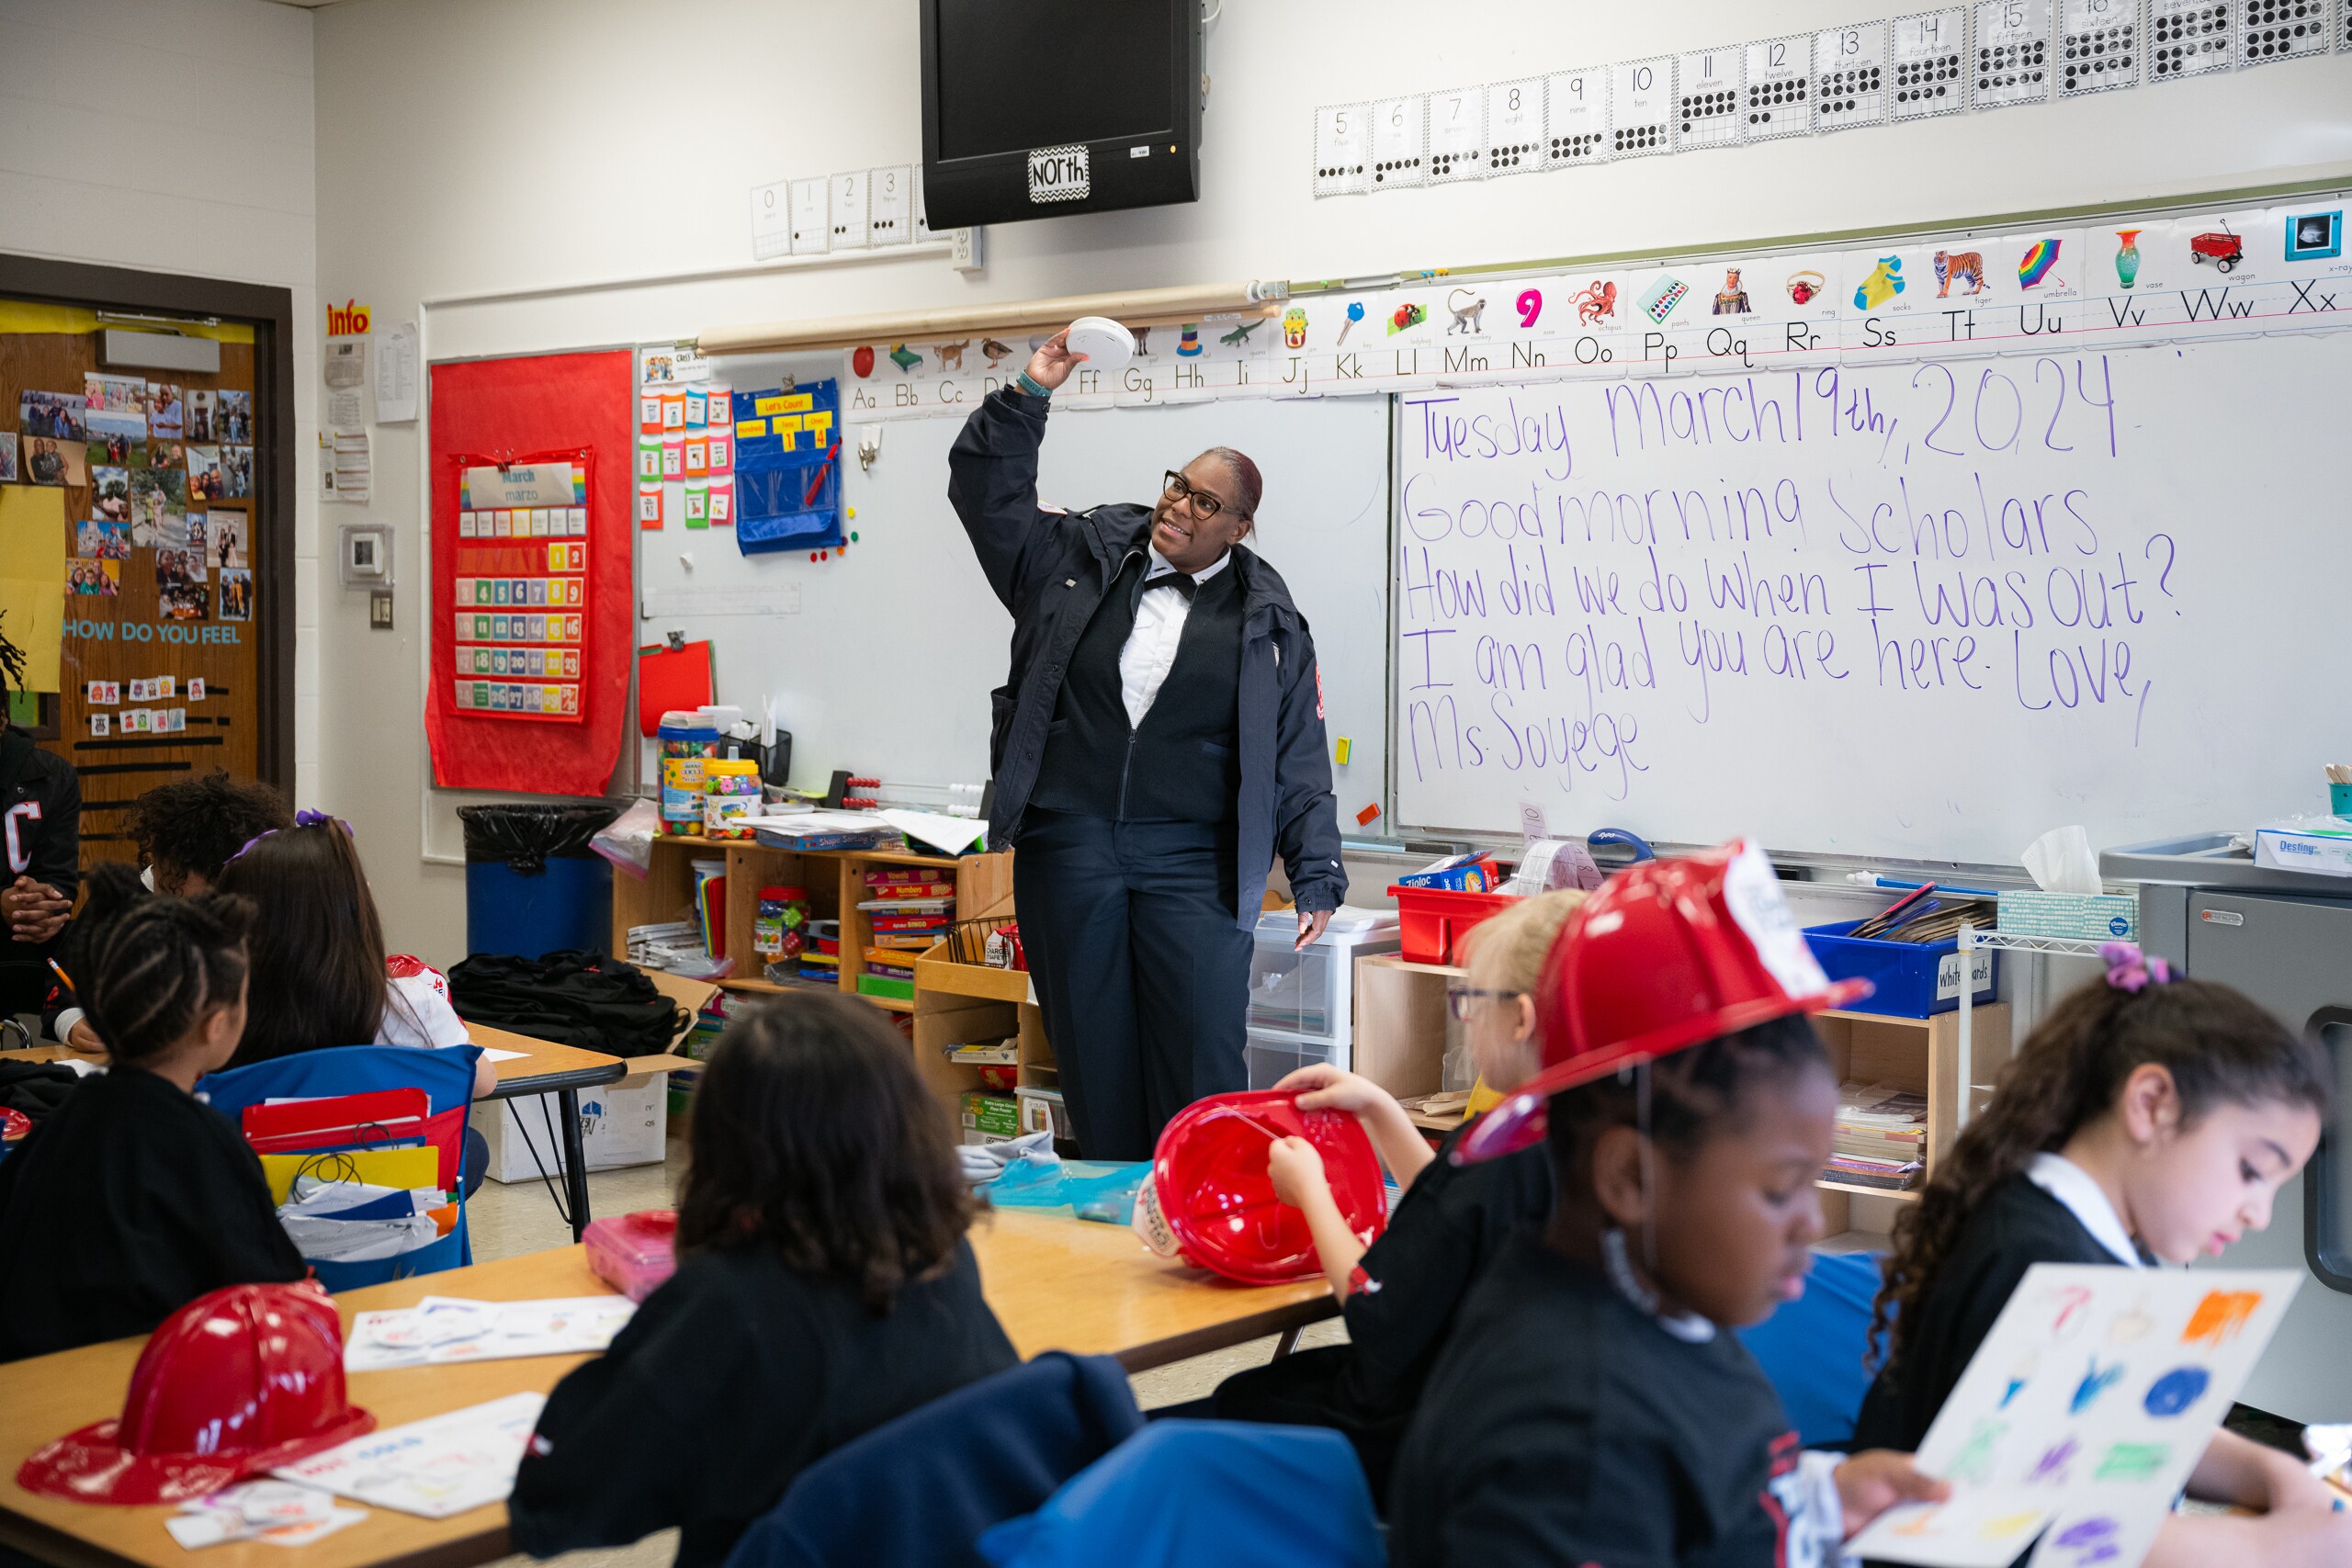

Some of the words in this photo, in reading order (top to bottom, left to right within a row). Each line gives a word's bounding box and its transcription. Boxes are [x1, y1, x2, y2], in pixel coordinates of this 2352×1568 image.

[2005, 3, 2024, 28] 15
[2081, 16, 2117, 28] sixteen
[1920, 17, 1939, 45] 14
[1996, 29, 2033, 42] fifteen
[1840, 31, 1860, 56] 13
[1909, 43, 1951, 57] fourteen
[1770, 43, 1785, 68] 12
[1835, 57, 1872, 71] thirteen
[1704, 55, 1712, 78] 11
[1764, 68, 1793, 80] twelve
[1570, 77, 1582, 101] 9
[1633, 67, 1653, 92] 10
[1696, 78, 1723, 90] eleven
[1449, 98, 1462, 121] 7
[1509, 88, 1521, 111] 8
[1634, 98, 1648, 109] ten
[1392, 105, 1403, 127] 6
[1505, 112, 1524, 126] eight
[1569, 104, 1587, 116] nine
[1336, 112, 1347, 134] 5
[1444, 126, 1466, 134] seven
[845, 177, 854, 197] 2
[886, 173, 895, 193] 3
[764, 190, 775, 209] 0
[2227, 272, 2256, 283] wagon
[2328, 263, 2352, 275] x-ray
[2043, 288, 2077, 299] umbrella
[2145, 280, 2164, 289] vase
[1974, 295, 1993, 307] tiger
[2180, 287, 2254, 321] Ww
[2289, 279, 2336, 314] Xx
[1821, 308, 1837, 319] ring
[1893, 303, 1912, 312] socks
[2109, 296, 2145, 328] Vv
[1598, 322, 1623, 334] octopus
[1670, 318, 1690, 330] paints
[1741, 314, 1761, 324] queen
[1941, 309, 1975, 341] Tt
[2020, 303, 2062, 335] Uu
[1409, 338, 1432, 347] ladybug
[1469, 333, 1492, 344] monkey
[1786, 321, 1821, 352] Rr
[1862, 318, 1896, 348] Ss
[1363, 342, 1373, 350] key
[1513, 341, 1545, 369] Nn
[1575, 336, 1612, 364] Oo
[1645, 332, 1678, 373] Pp
[1706, 327, 1754, 368] Qq
[1337, 353, 1363, 379] Kk
[1396, 348, 1417, 376] Ll
[1444, 346, 1488, 373] Mm
[1080, 369, 1101, 394] Ff
[1175, 364, 1204, 389] Hh
[1238, 360, 1248, 385] Ii
[1283, 356, 1307, 394] Jj
[939, 380, 963, 403] Cc
[1125, 367, 1152, 402] Gg
[853, 388, 876, 409] Aa
[896, 383, 918, 407] Bb
[765, 401, 782, 412] Let's
[783, 399, 804, 410] Count
[1405, 397, 1572, 480] Tuesday
[1606, 378, 1786, 457] March
[1913, 355, 2116, 457] 2024
[786, 433, 792, 449] 1
[817, 429, 824, 446] 4
[502, 469, 536, 484] March
[505, 489, 538, 502] marzo
[555, 551, 560, 564] 1
[571, 550, 580, 564] 2
[479, 586, 488, 602] 4
[498, 586, 505, 602] 5
[515, 583, 524, 600] 6
[534, 586, 542, 602] 7
[552, 583, 560, 599] 8
[570, 586, 579, 602] 9
[1403, 546, 1487, 622] How
[1500, 544, 1555, 616] did
[1639, 546, 1688, 613] do
[1854, 562, 1894, 617] I
[62, 618, 115, 641] HOW
[121, 622, 153, 642] DO
[156, 624, 198, 645] YOU
[201, 626, 242, 646] FEEL
[478, 621, 488, 634] 11
[495, 621, 506, 634] 12
[513, 621, 525, 637] 13
[530, 622, 543, 637] 14
[549, 622, 561, 637] 15
[566, 619, 579, 635] 16
[475, 652, 489, 668] 18
[493, 656, 506, 671] 19
[511, 656, 525, 669] 20
[530, 657, 541, 669] 21
[548, 657, 560, 670] 22
[564, 657, 577, 673] 23
[1402, 628, 1456, 691] I
[1476, 634, 1547, 690] am
[1566, 616, 1657, 733] glad
[1679, 619, 1748, 724] you
[1763, 624, 1849, 680] are
[1871, 617, 1991, 690] here.
[492, 688, 506, 704] 26
[509, 691, 522, 706] 27
[526, 689, 541, 705] 28
[545, 694, 558, 708] 29
[1409, 694, 1490, 783] Ms.
[1490, 691, 1650, 802] Soyege
[5, 801, 41, 874] C
[819, 838, 841, 847] Shape
[842, 835, 868, 844] Sorting
[2279, 840, 2314, 855] Destiny
[888, 872, 910, 880] Vowels
[896, 886, 923, 894] Numbers
[881, 951, 914, 962] Subtraction
